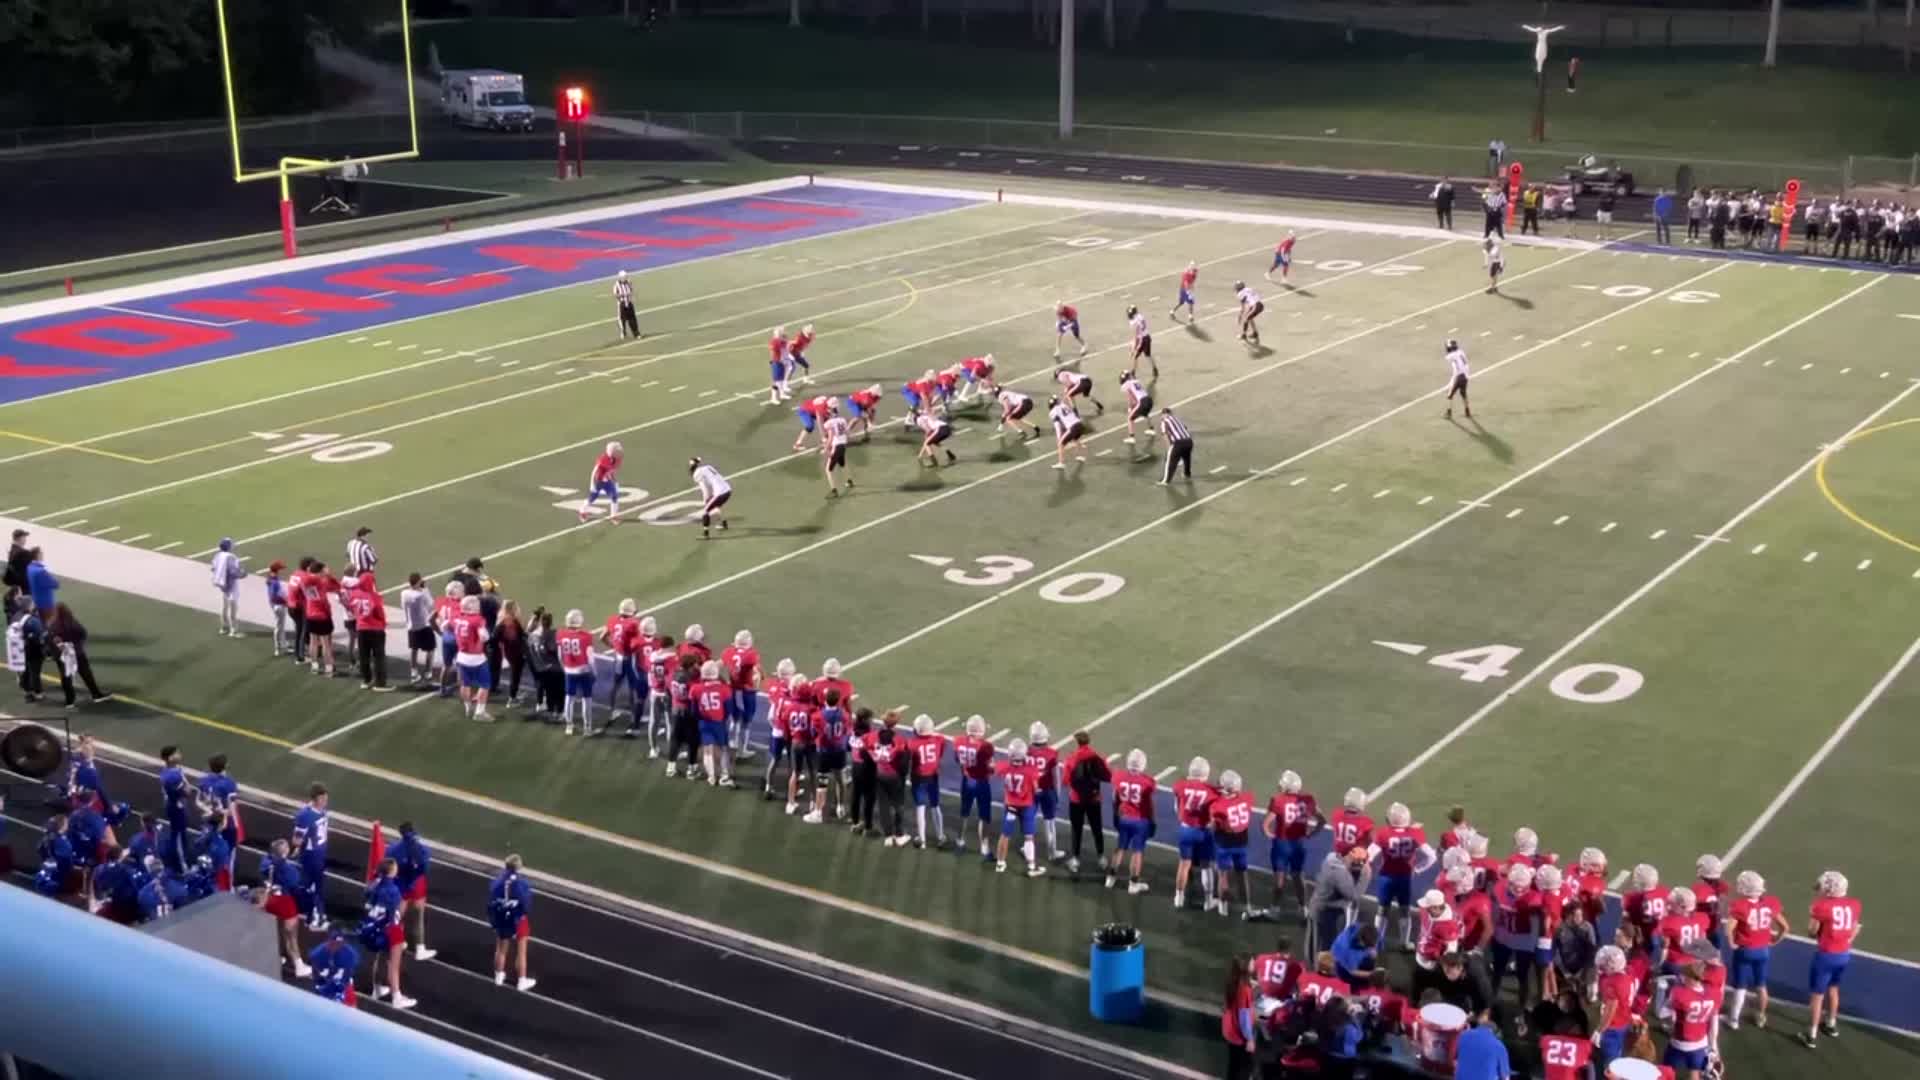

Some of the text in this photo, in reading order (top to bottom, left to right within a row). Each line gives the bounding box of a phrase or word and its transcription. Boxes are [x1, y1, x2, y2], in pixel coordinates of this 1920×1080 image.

[0, 202, 862, 378] ONCALLI
[1602, 284, 1721, 303] 30
[266, 433, 392, 462] 10
[944, 555, 1125, 603] 30
[1427, 644, 1644, 703] 40
[701, 691, 721, 711] 45
[918, 743, 937, 765] 15
[1119, 782, 1141, 804] 33
[1184, 787, 1207, 810] 77
[1227, 802, 1249, 827] 55
[1337, 821, 1358, 844] 16
[1747, 906, 1772, 931] 46
[1832, 906, 1852, 931] 91
[1263, 959, 1286, 984] 19
[1686, 999, 1714, 1024] 27
[1546, 1039, 1577, 1067] 23
